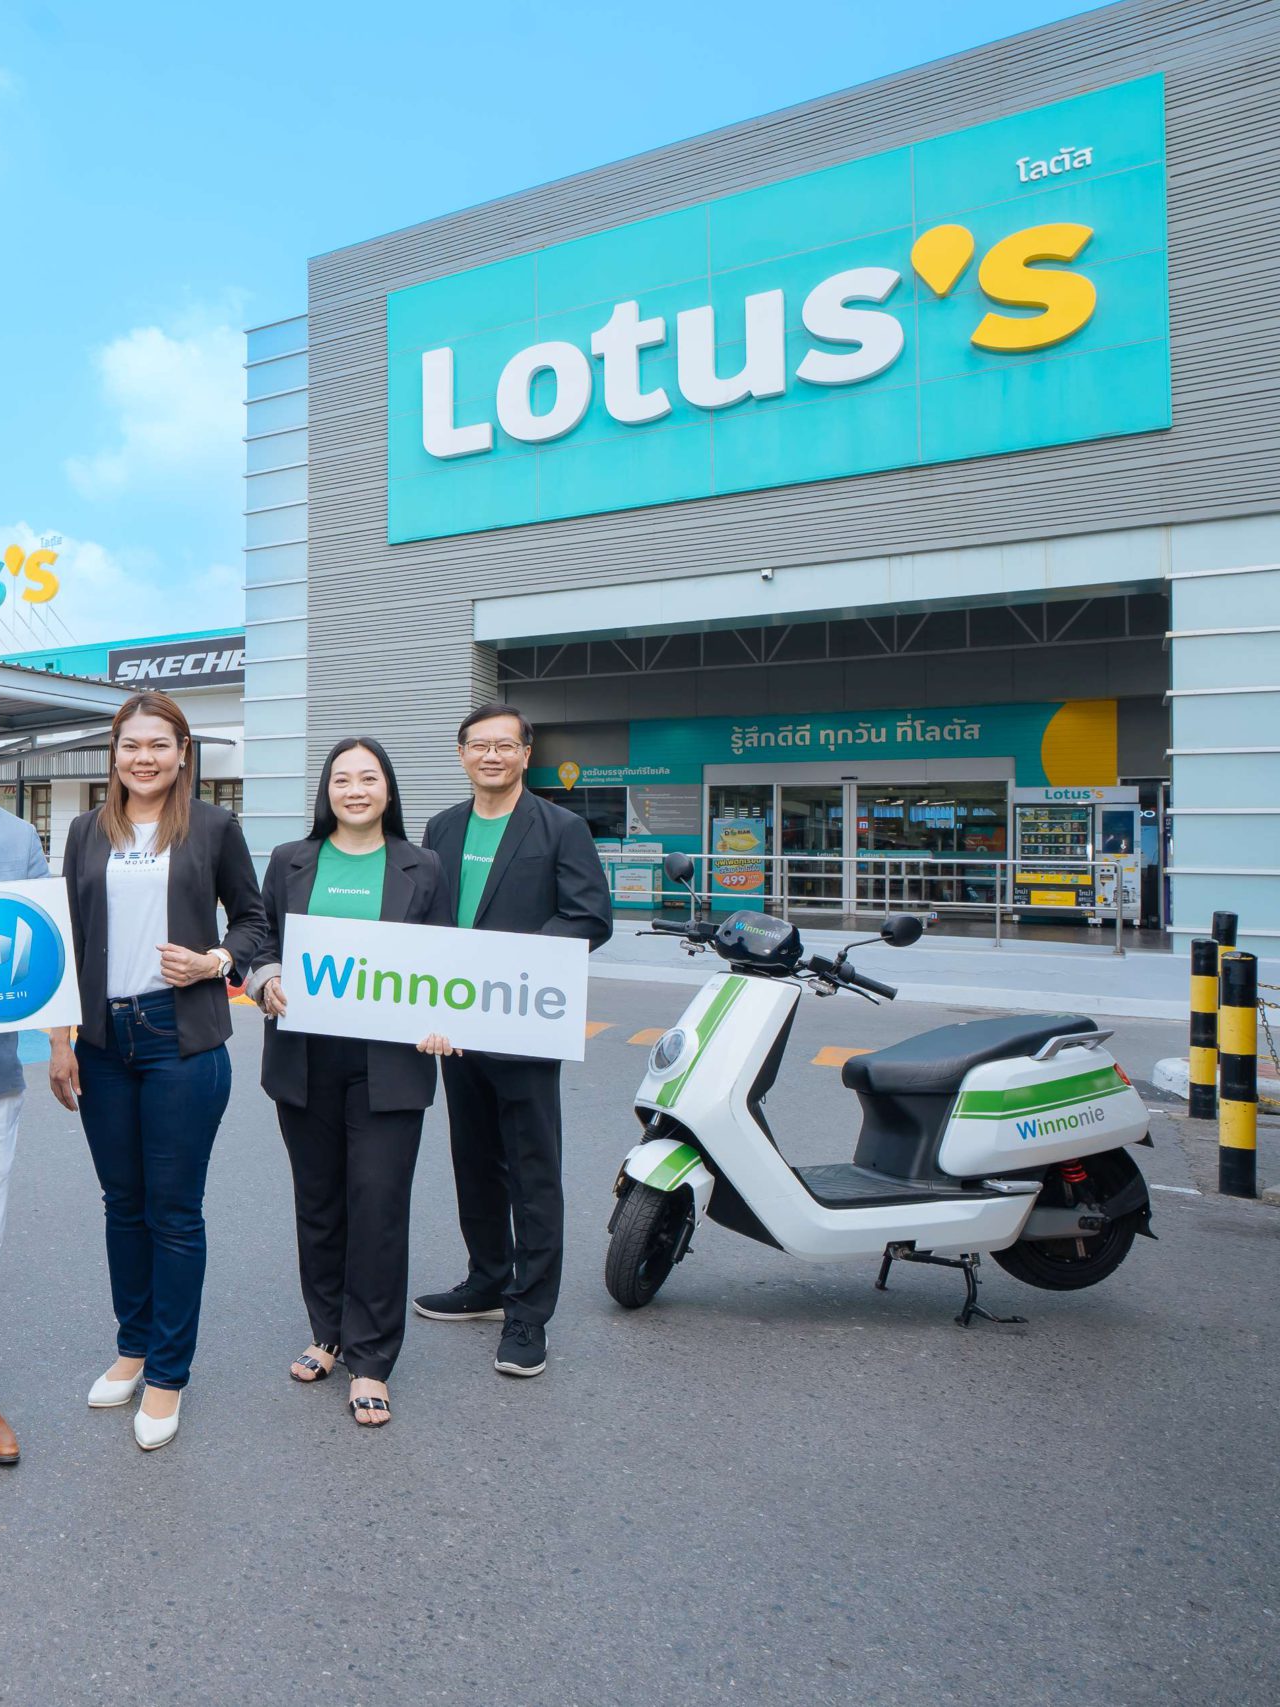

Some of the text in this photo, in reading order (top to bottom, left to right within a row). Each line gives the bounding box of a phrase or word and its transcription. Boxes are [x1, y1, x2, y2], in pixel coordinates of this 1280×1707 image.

[1016, 145, 1094, 183] โลตัส
[422, 221, 1097, 460] Lotus's
[731, 714, 981, 755] รู้สึกดีดี ทุกวัน ที่โลตัส
[1044, 789, 1104, 800] Lotus's
[327, 886, 370, 896] Winnonie
[722, 875, 746, 885] 499
[735, 920, 781, 940] Winnonie
[302, 952, 567, 1020] Winnonie
[1016, 1105, 1105, 1141] Winnonie
